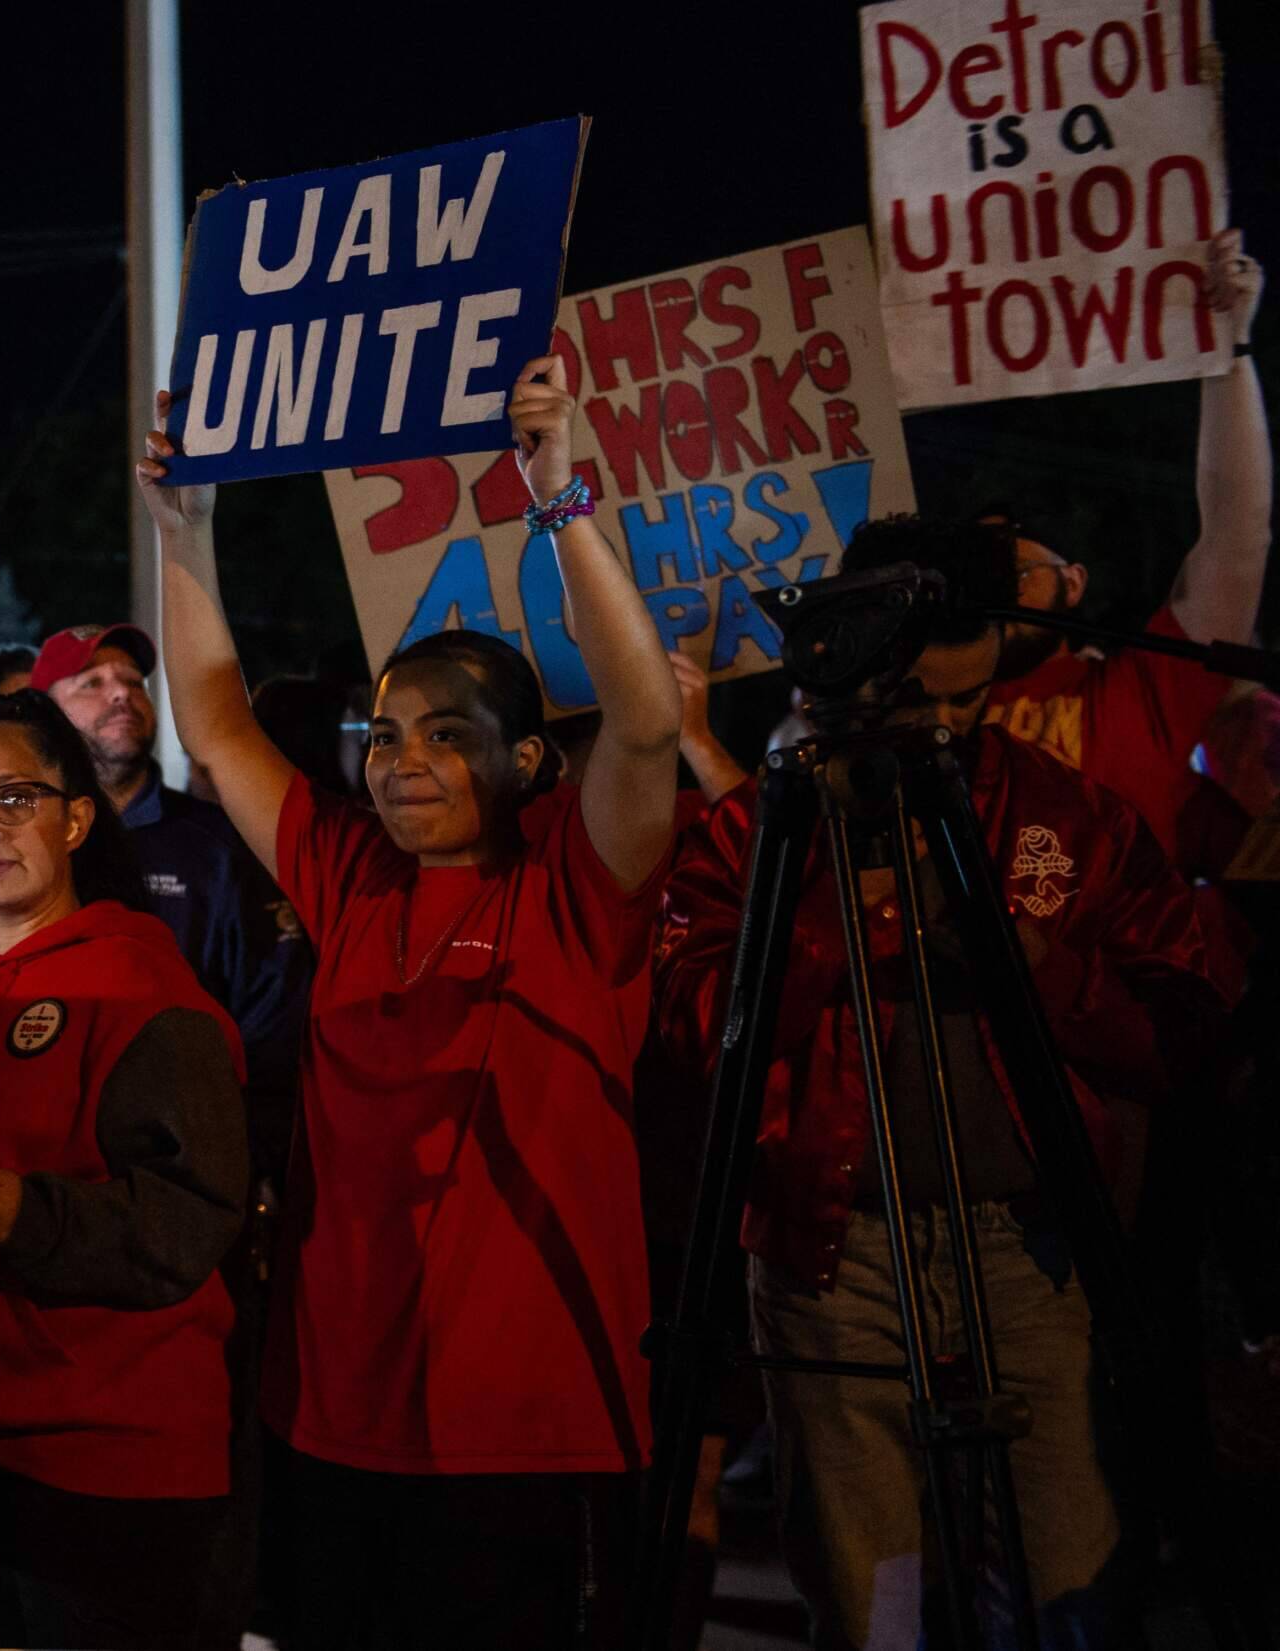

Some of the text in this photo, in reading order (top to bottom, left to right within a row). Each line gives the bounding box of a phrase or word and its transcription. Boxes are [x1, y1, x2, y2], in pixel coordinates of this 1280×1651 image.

[968, 105, 1114, 171] is a
[238, 149, 507, 296] UAW
[893, 155, 1211, 272] union
[182, 288, 522, 457] UNITE
[577, 266, 761, 393] HRS
[932, 261, 1215, 386] town
[584, 350, 820, 498] WORK
[642, 553, 828, 671] PA
